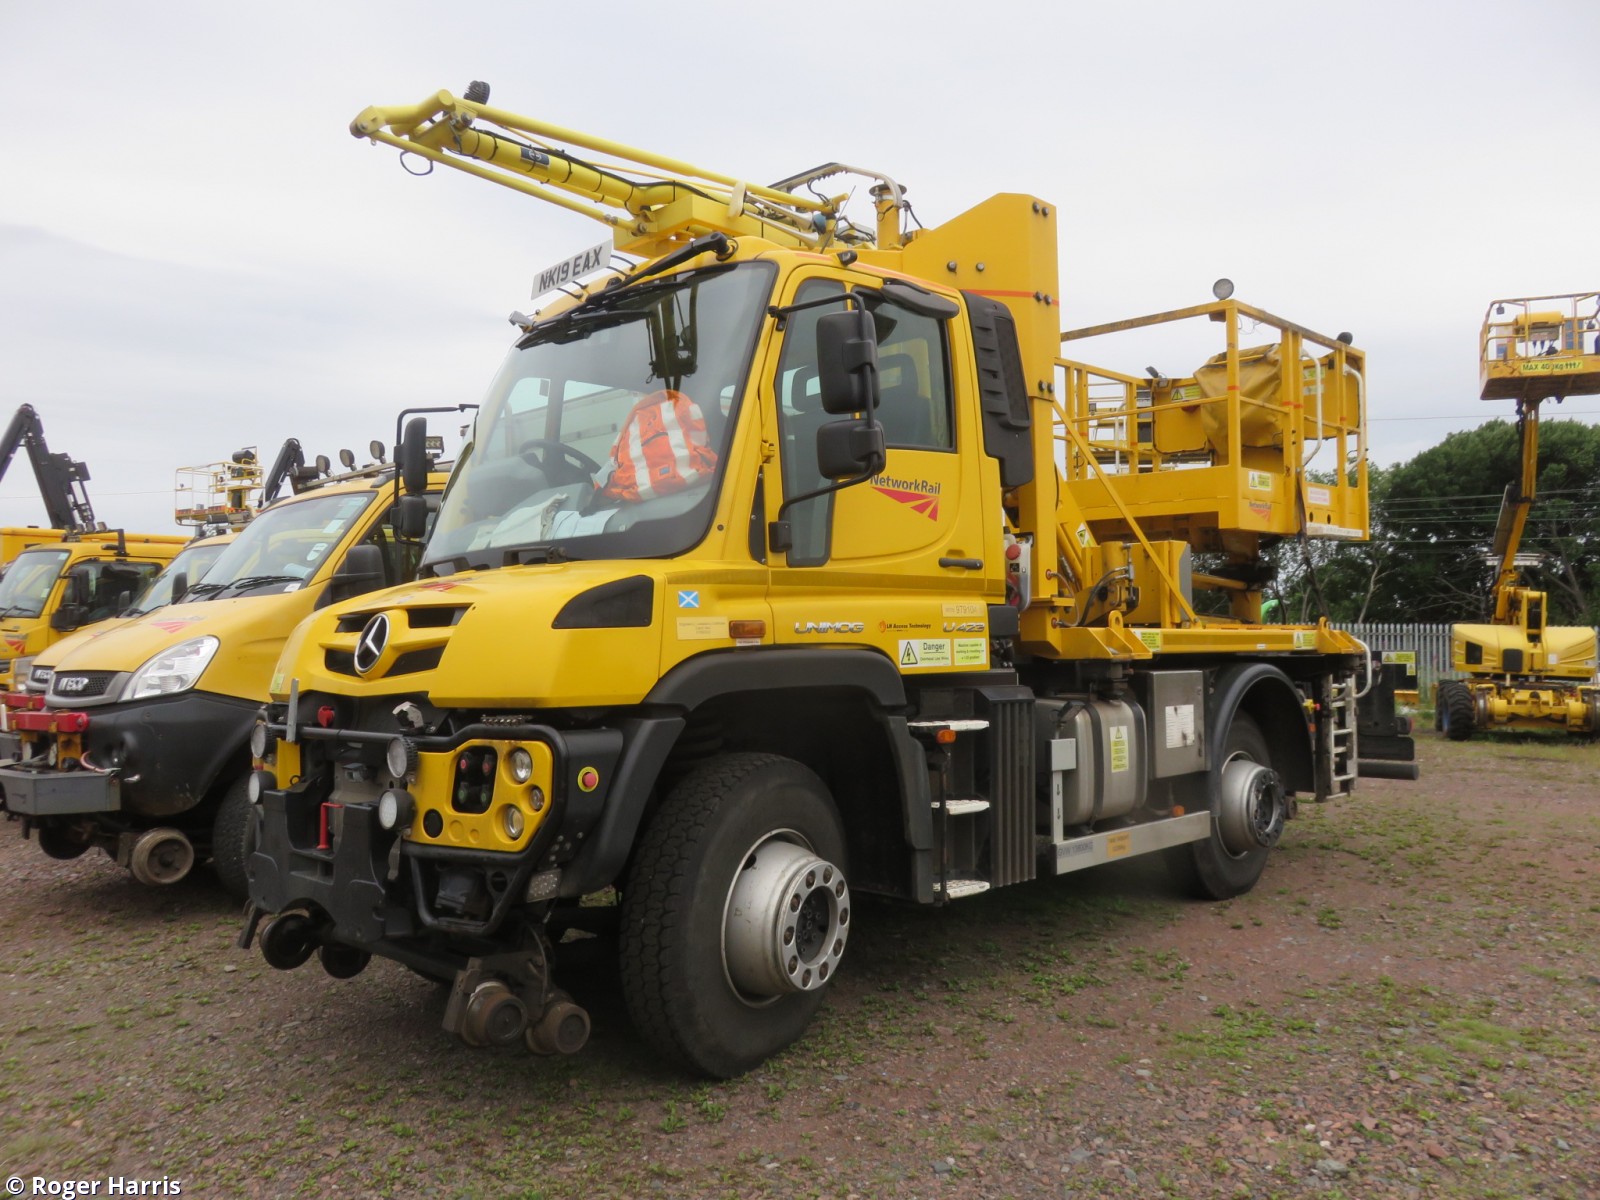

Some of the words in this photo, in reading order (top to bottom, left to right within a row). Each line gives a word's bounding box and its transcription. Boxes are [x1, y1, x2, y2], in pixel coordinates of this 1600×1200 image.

[539, 261, 570, 293] NK19
[572, 245, 602, 276] EAX
[1522, 363, 1539, 371] MAX
[870, 474, 941, 495] NetworkRail
[794, 621, 864, 634] UNIMOG
[956, 622, 985, 633] 423
[923, 642, 945, 652] Danger
